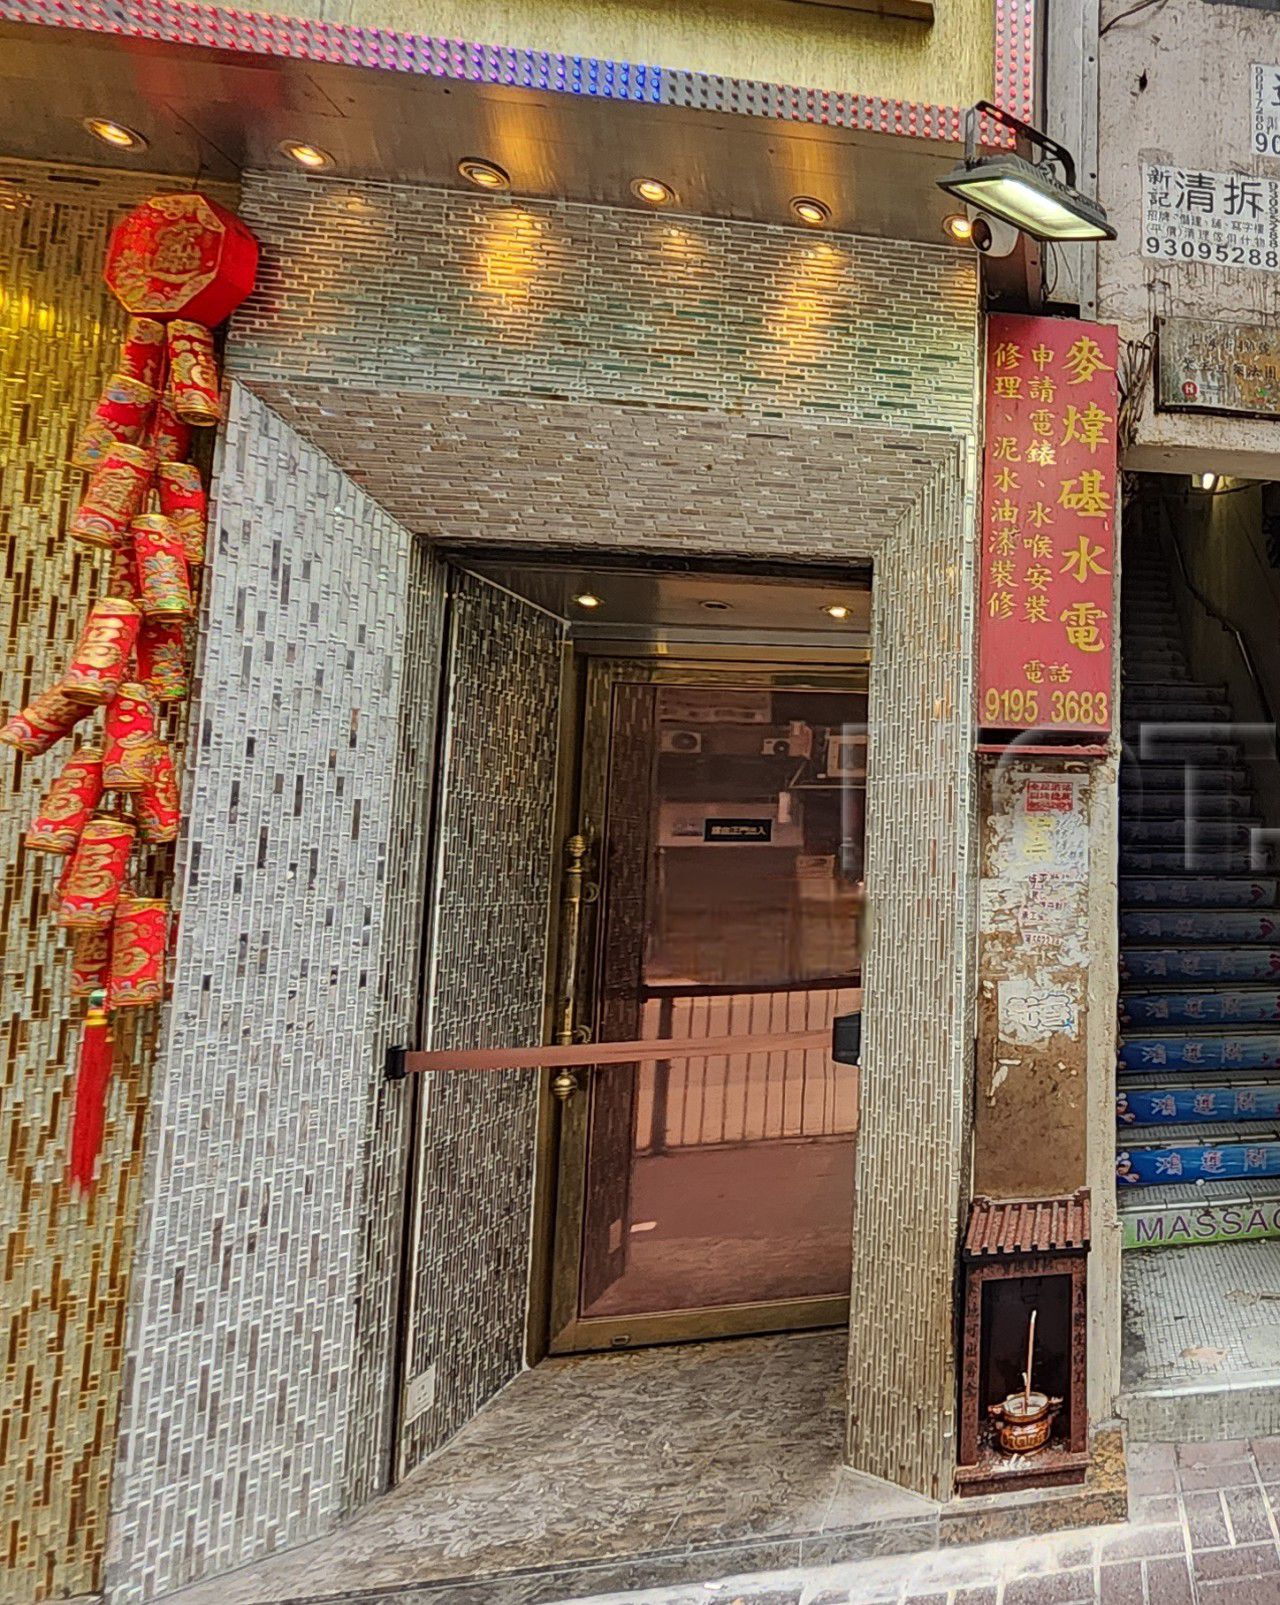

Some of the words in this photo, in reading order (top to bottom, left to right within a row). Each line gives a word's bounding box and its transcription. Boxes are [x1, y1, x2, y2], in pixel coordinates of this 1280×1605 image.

[1146, 166, 1173, 209] 新記
[1175, 171, 1265, 219] 清拆
[1146, 236, 1279, 268] 93095288
[1022, 660, 1073, 684] 電話
[985, 687, 1039, 722] 9195
[1051, 690, 1109, 725] 3683
